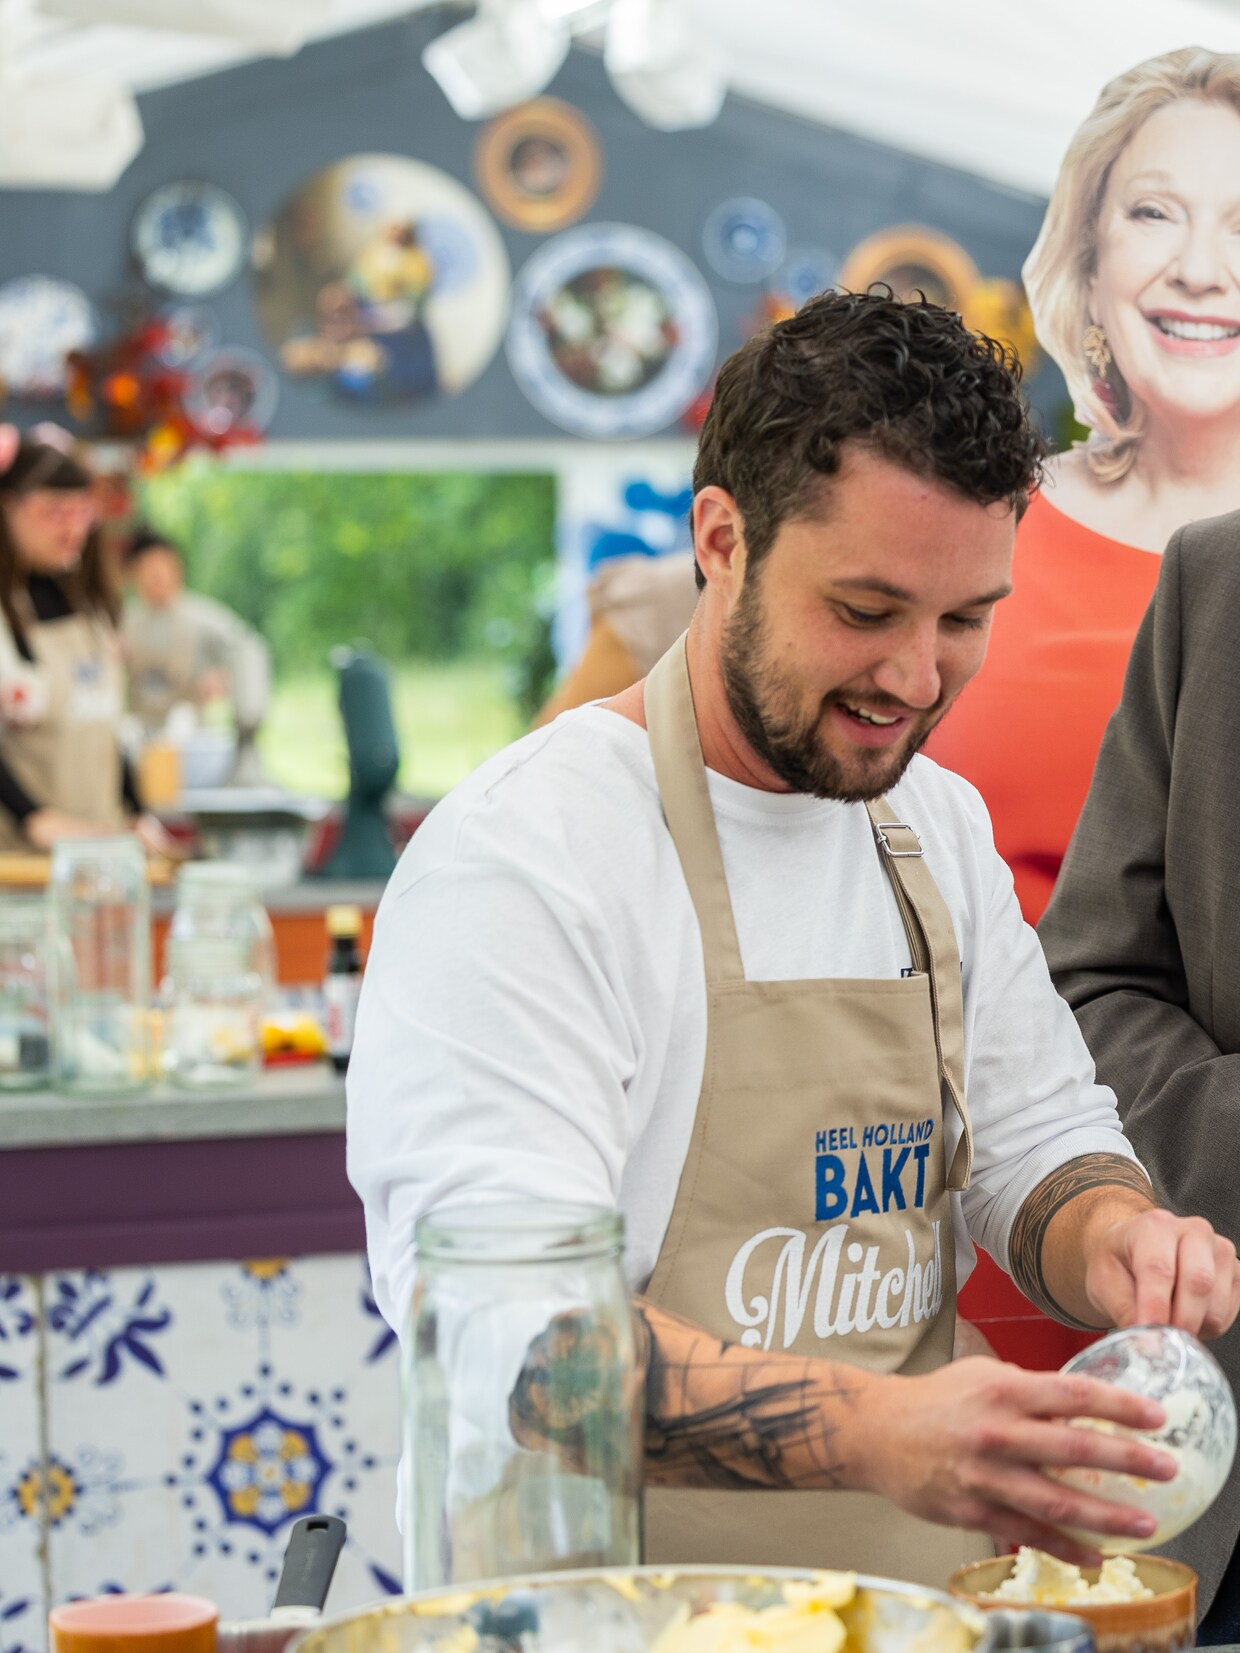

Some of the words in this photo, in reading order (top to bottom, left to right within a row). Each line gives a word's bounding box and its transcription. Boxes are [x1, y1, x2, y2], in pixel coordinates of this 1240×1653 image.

[816, 1126, 857, 1153] HEEL
[862, 1119, 934, 1148] HOLLAND
[815, 1143, 930, 1222] BAKT
[725, 1220, 943, 1352] Mitchell
